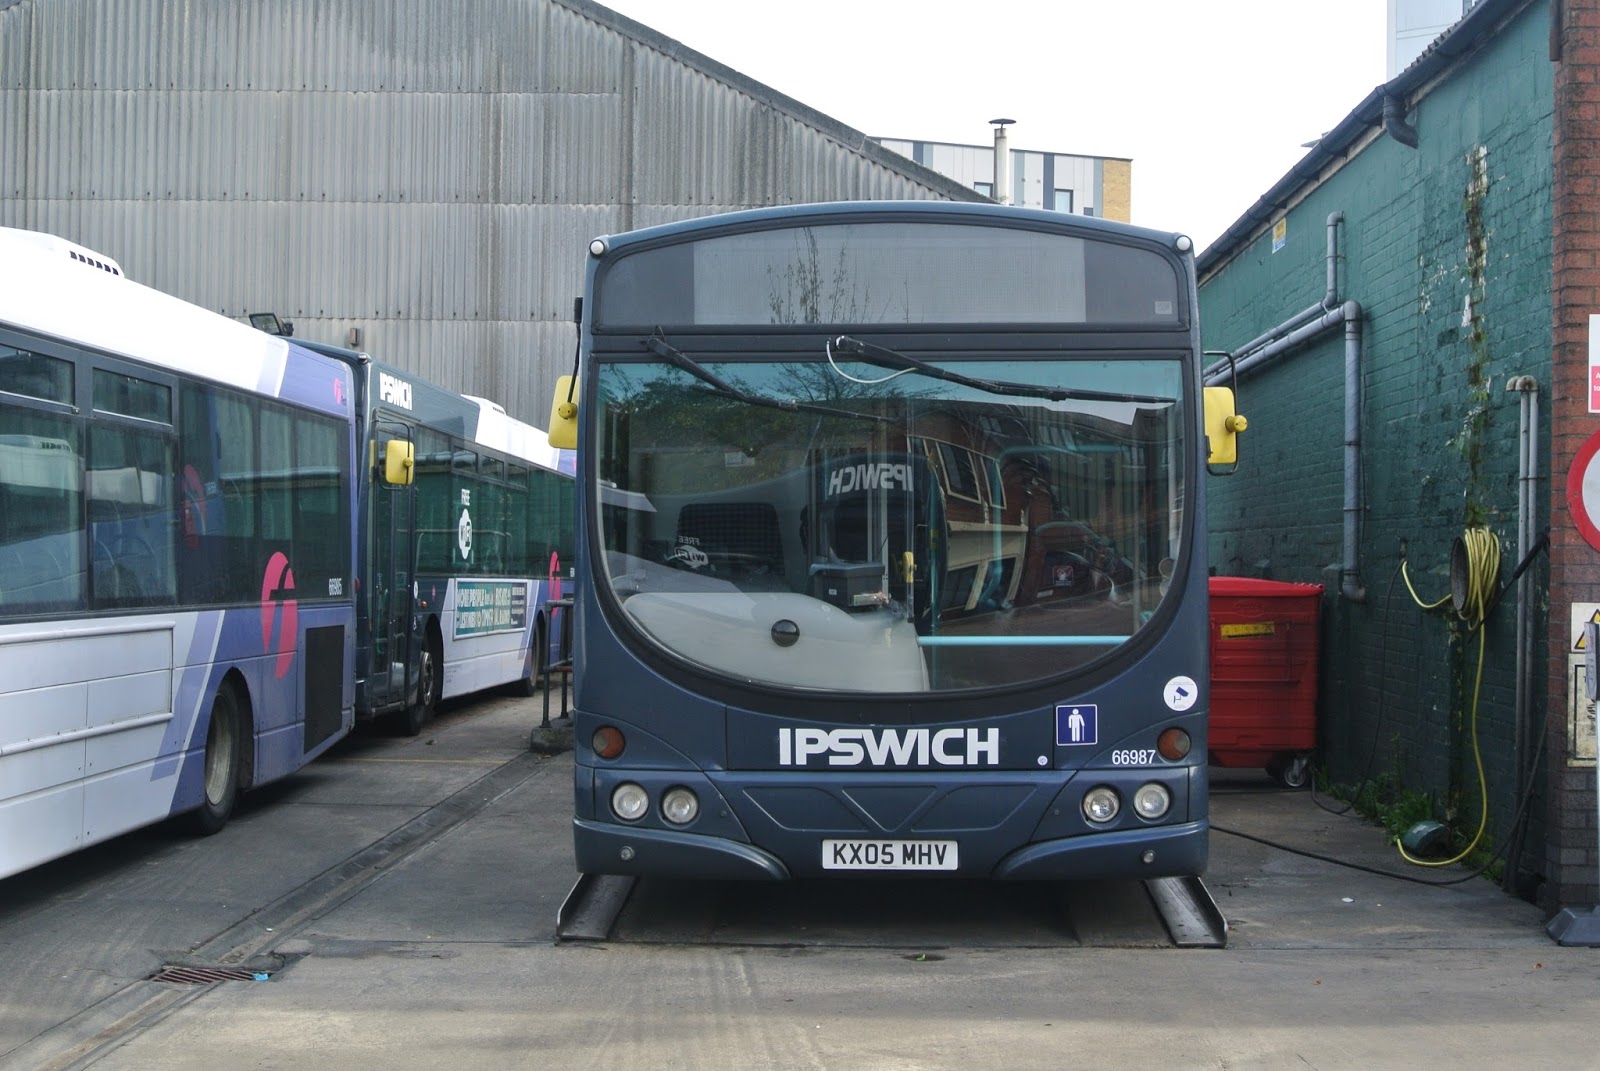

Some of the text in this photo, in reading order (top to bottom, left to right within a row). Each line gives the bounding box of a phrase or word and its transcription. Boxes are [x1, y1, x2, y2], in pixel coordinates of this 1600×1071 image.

[779, 727, 1000, 766] IPSWICH
[1111, 749, 1157, 766] 66987
[833, 843, 948, 866] KX05 MHV
